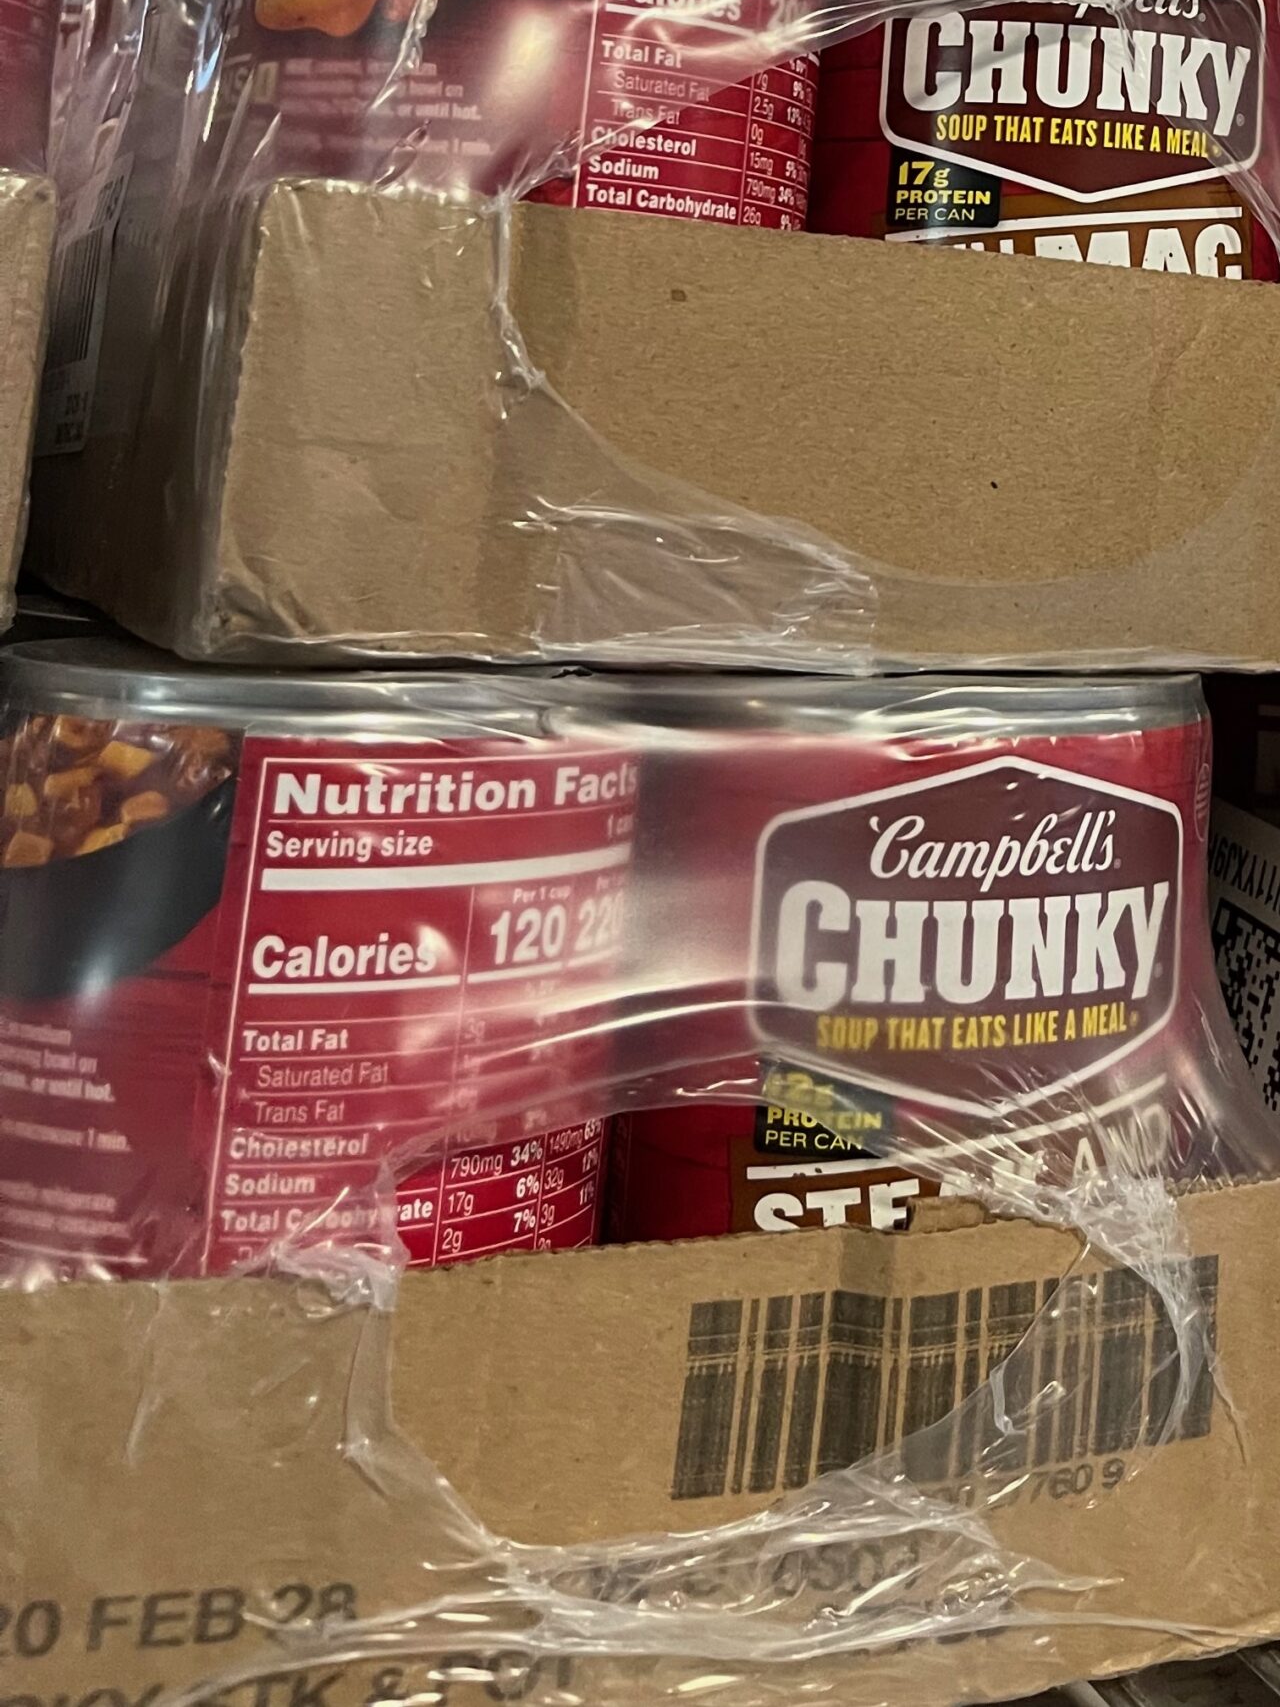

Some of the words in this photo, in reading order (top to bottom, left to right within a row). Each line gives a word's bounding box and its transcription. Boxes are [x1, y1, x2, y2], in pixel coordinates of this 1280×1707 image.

[601, 40, 650, 63] Total
[903, 11, 1251, 136] CHUNKY
[592, 125, 697, 156] Cholesterol
[936, 114, 987, 142] SOUP
[994, 115, 1045, 144] THAT
[1051, 117, 1097, 147] EATS
[1103, 121, 1145, 151] LIKE
[1166, 126, 1210, 158] MEAL
[588, 155, 660, 180] Sodium
[898, 160, 949, 188] 17g
[586, 183, 631, 206] Total
[635, 188, 737, 222] Carbohydrate
[896, 190, 991, 205] PROTEIN
[895, 207, 929, 222] PER
[934, 208, 976, 222] CAN
[272, 772, 535, 815] Nutrition
[554, 763, 639, 804] Facts
[265, 829, 371, 861] Serving
[379, 833, 432, 856] size
[869, 809, 1117, 892] Campbell's
[252, 931, 437, 978] Calories
[491, 904, 566, 966] 120
[776, 880, 1170, 1011] CHUNKY
[242, 1030, 302, 1052] Total
[310, 1029, 348, 1051] Fat
[817, 1015, 876, 1050] SOUP
[887, 1016, 945, 1050] THAT
[951, 1013, 1006, 1048] EATS
[1012, 1010, 1059, 1044] LIKE
[1083, 1003, 1127, 1036] MEAL
[257, 1063, 353, 1087] Saturated
[358, 1061, 388, 1085] Fat
[255, 1101, 307, 1123] Trans
[314, 1099, 344, 1122] Fat
[766, 1108, 882, 1129] PROTEIN
[229, 1132, 368, 1159] Cholesterol
[765, 1131, 806, 1149] PER
[814, 1132, 863, 1150] CAN
[225, 1173, 316, 1196] Sodium
[451, 1154, 503, 1178] 790mg
[510, 1141, 543, 1167] 34%
[221, 1209, 281, 1233] Total
[86, 1588, 243, 1651] FEB
